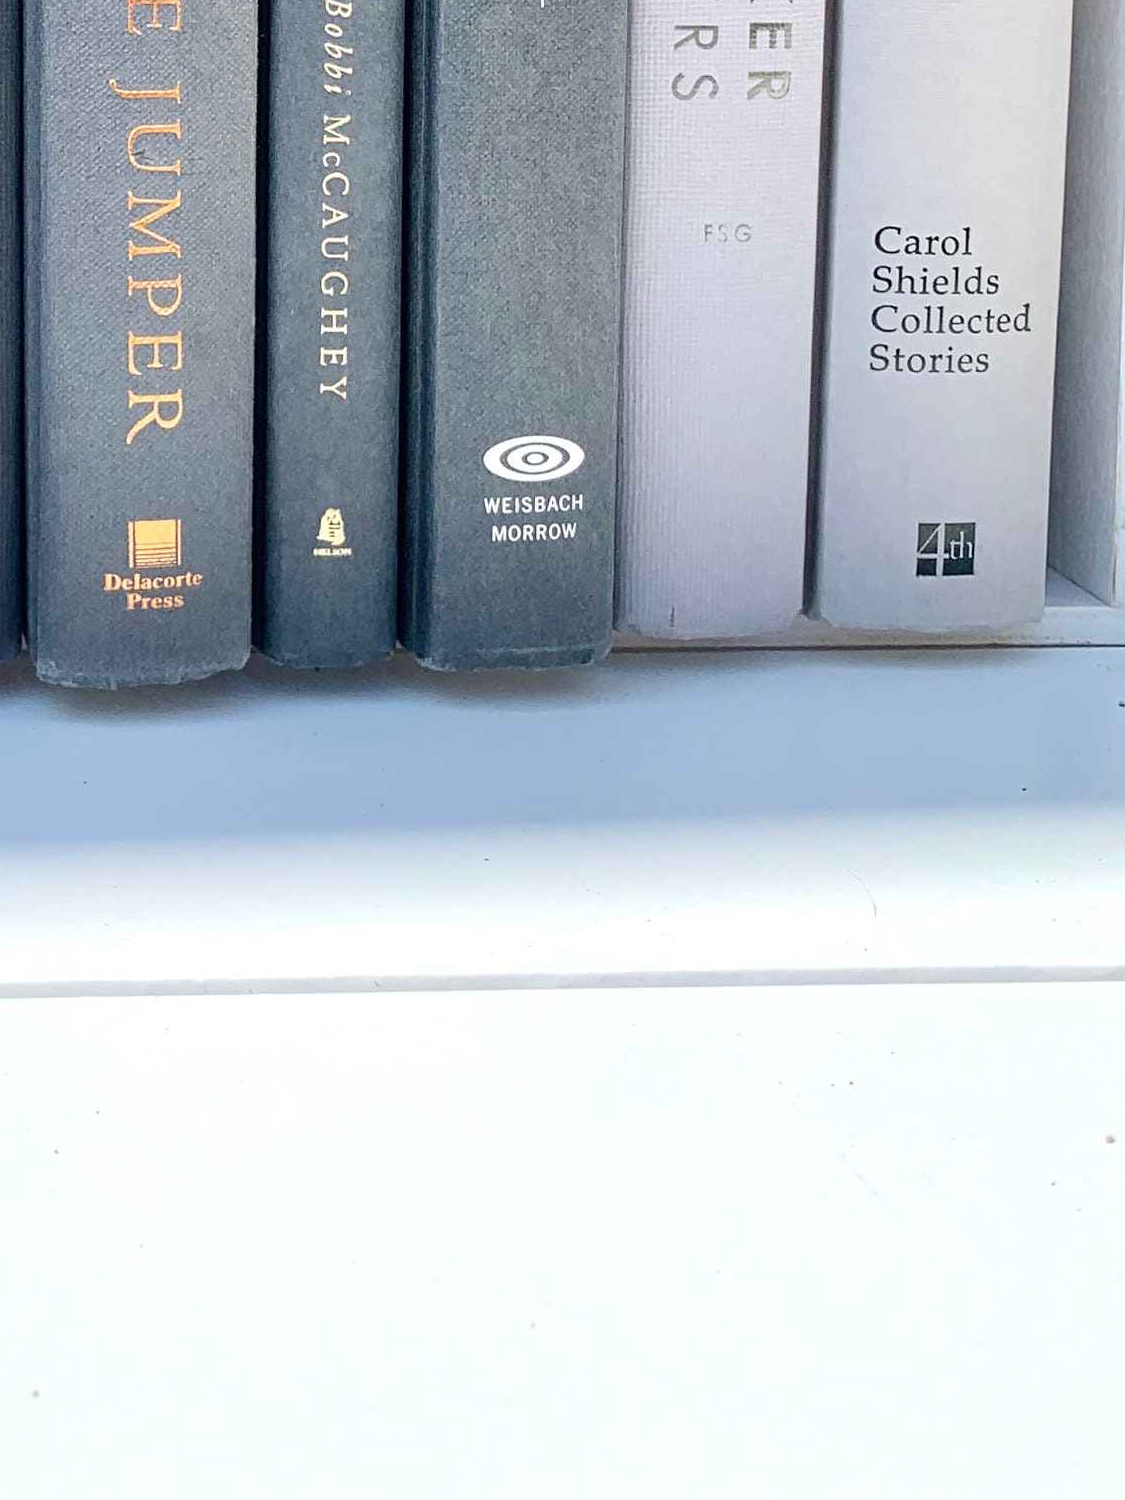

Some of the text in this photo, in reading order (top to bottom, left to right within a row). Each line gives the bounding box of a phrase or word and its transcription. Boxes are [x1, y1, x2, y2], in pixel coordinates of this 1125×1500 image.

[704, 224, 752, 243] FSG
[874, 226, 972, 256] Carol
[109, 78, 184, 444] JUMPER
[319, 113, 351, 402] McCAUGHEY
[872, 265, 1000, 296] Shields
[870, 303, 1031, 334] Collected
[869, 343, 990, 374] Stories
[483, 494, 583, 514] WEISBACH
[491, 522, 577, 542] MORROW
[103, 571, 203, 591] Delacorte
[126, 592, 185, 611] Press
